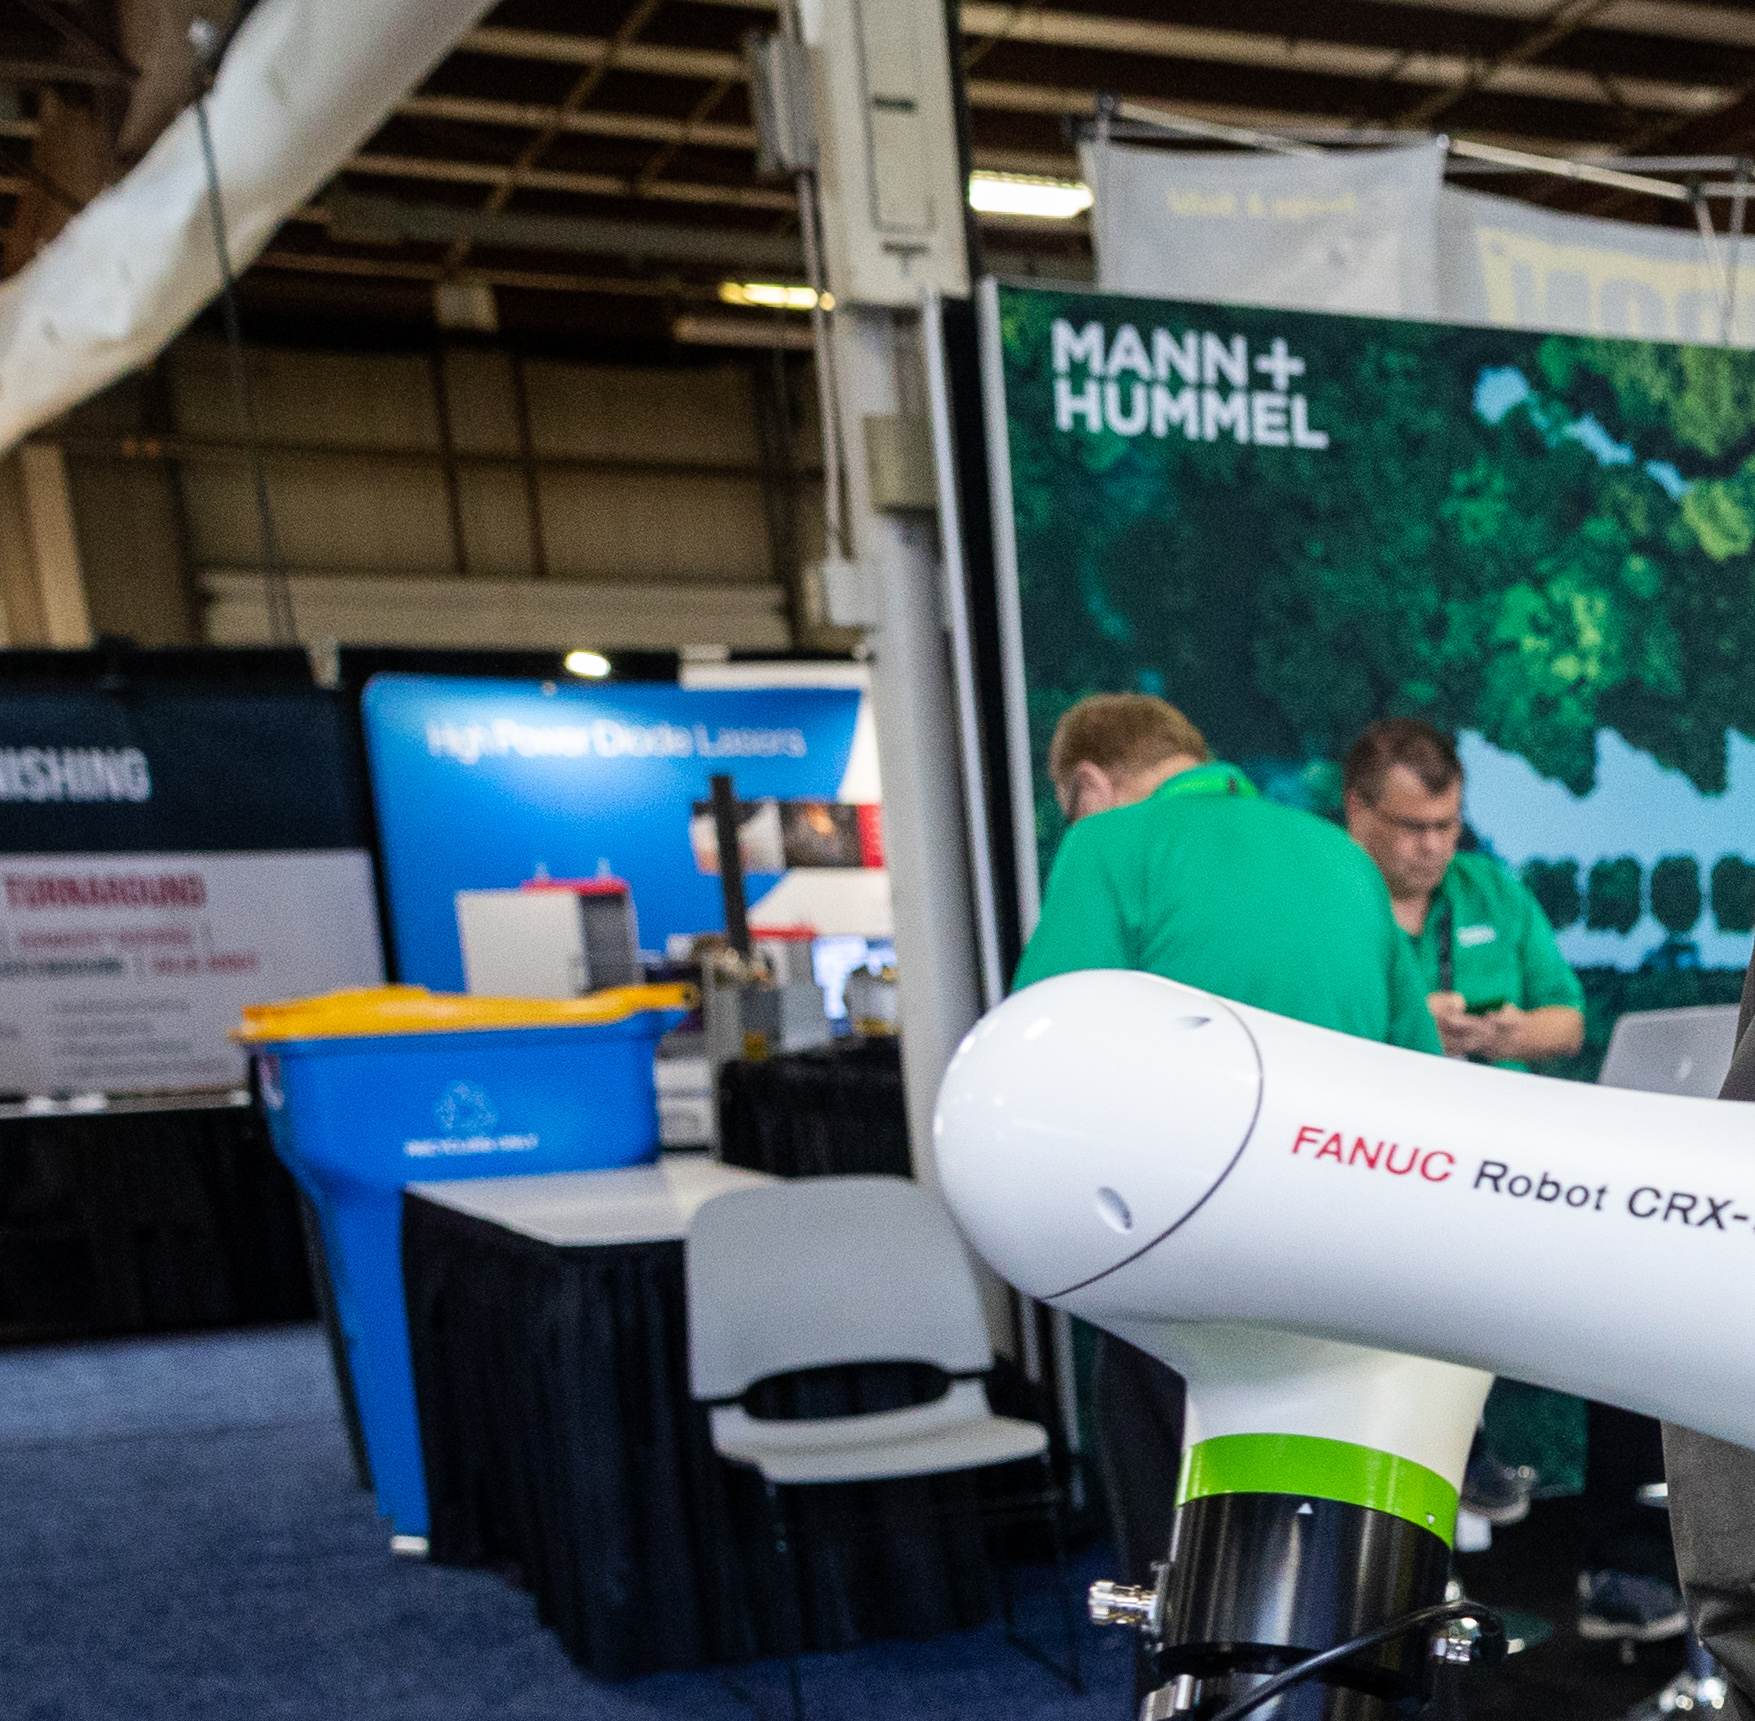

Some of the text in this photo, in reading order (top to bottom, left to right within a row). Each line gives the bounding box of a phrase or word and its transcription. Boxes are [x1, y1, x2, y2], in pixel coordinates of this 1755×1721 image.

[1055, 376, 1330, 450] HUMMEL
[426, 717, 808, 765] High Power Diode Lasers
[4, 873, 207, 910] TURNAROUND
[1291, 1125, 1458, 1183] FANUC
[1473, 1160, 1606, 1212] Robot
